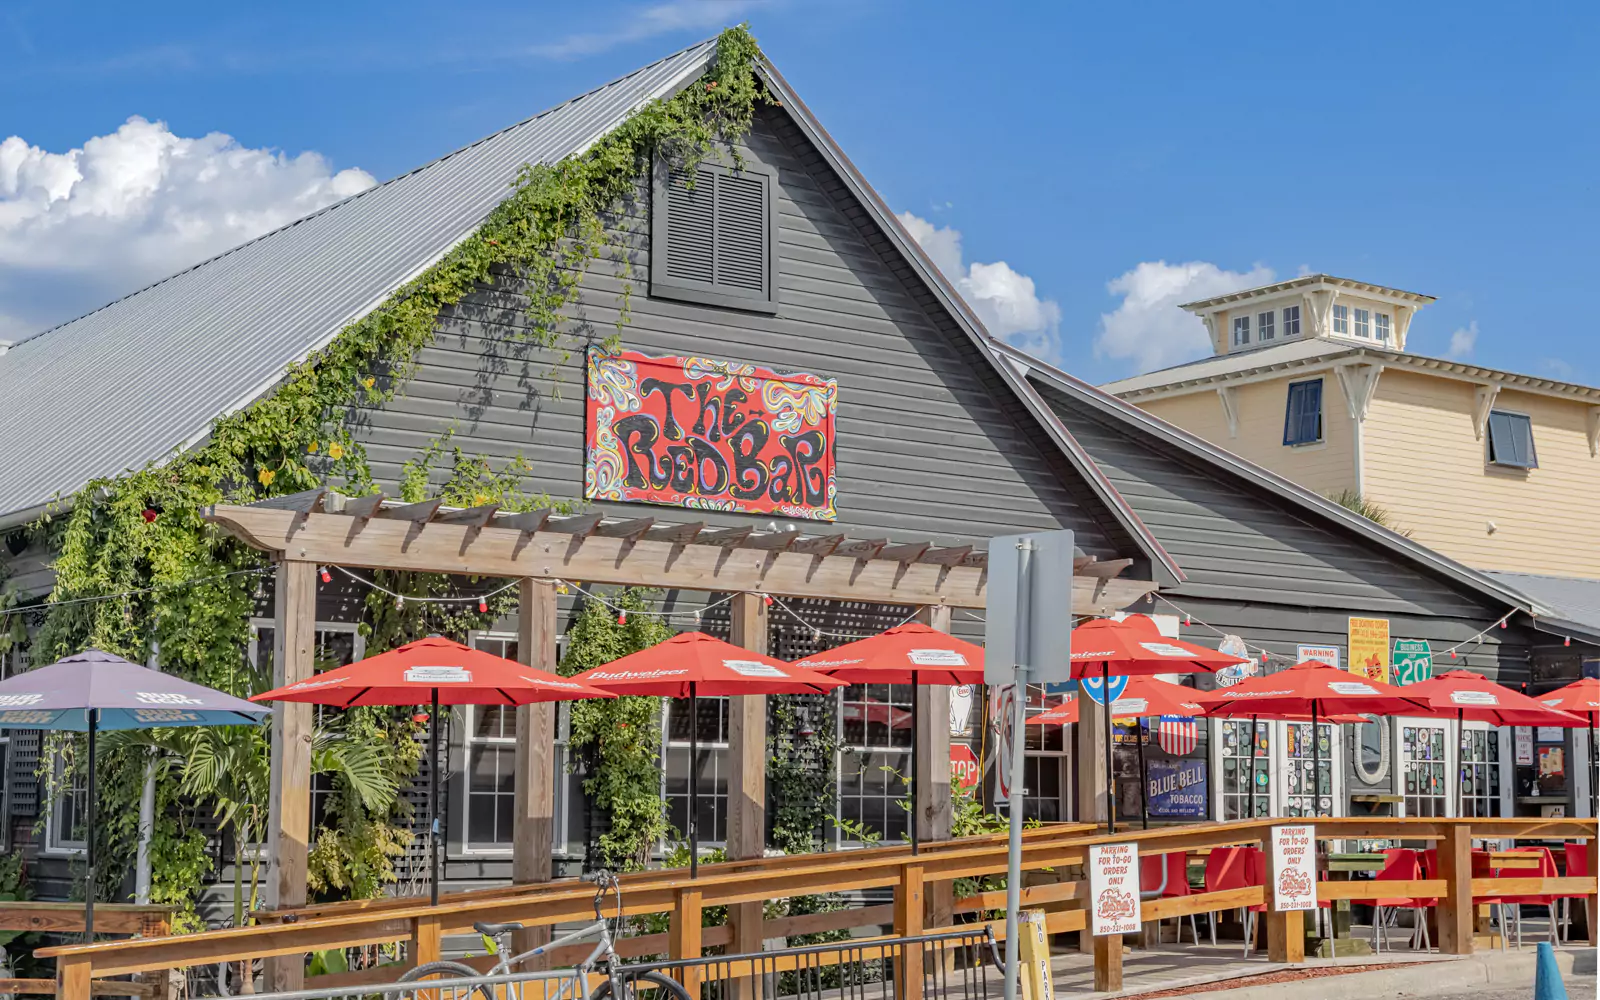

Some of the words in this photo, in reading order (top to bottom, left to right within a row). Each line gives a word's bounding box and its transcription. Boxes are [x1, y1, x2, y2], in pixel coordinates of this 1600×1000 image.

[1400, 643, 1424, 652] BUSINESS
[1303, 649, 1334, 657] WARNING
[586, 669, 689, 680] Budweiser
[1401, 658, 1427, 685] 20
[950, 761, 976, 780] TOP
[1150, 774, 1177, 797] BLUE
[1178, 766, 1204, 789] BELL
[1170, 794, 1204, 804] TOBACCO
[1281, 828, 1306, 836] PARKING
[1279, 838, 1290, 846] FOR
[1291, 837, 1309, 845] TO-GO
[1101, 845, 1128, 855] PARKING
[1283, 847, 1306, 855] ORDERS
[1098, 857, 1111, 865] FOR
[1112, 856, 1132, 864] TO-GO
[1287, 857, 1301, 865] ONLY
[1103, 866, 1128, 875] ORDERS
[1108, 877, 1124, 885] ONLY
